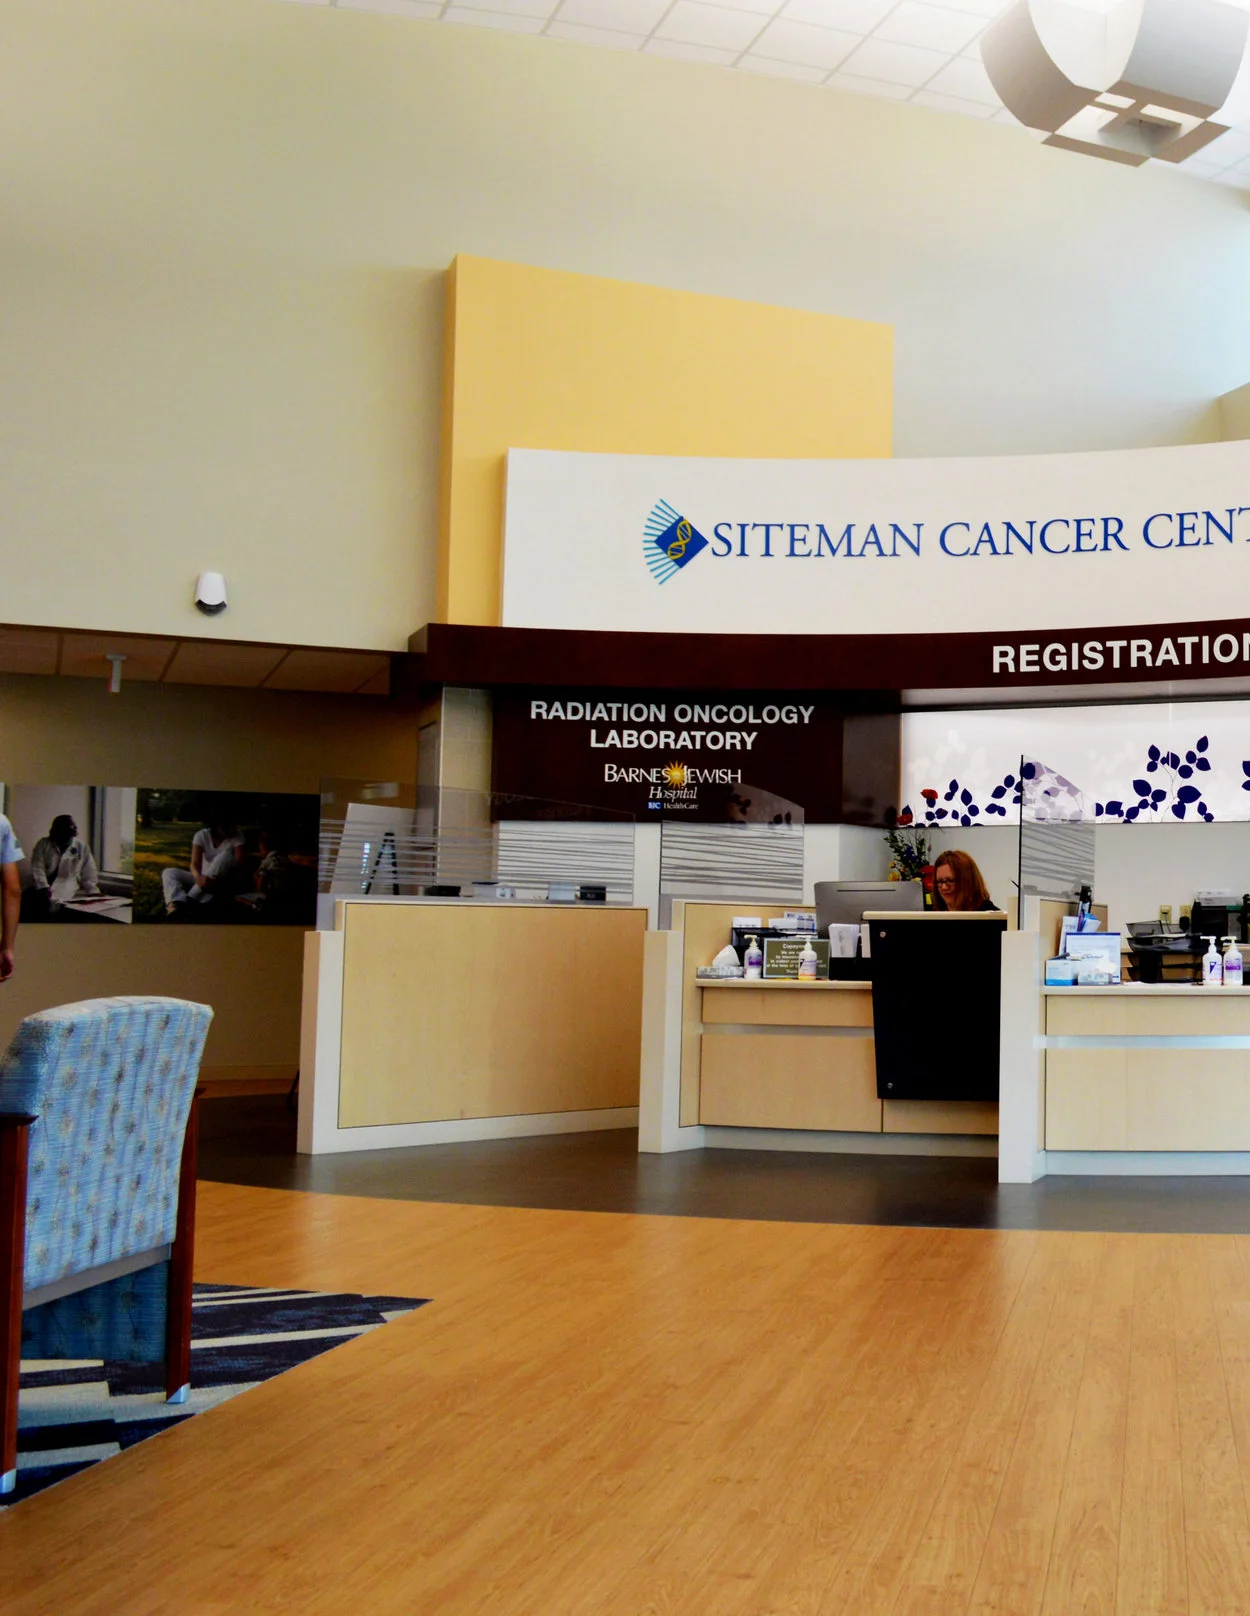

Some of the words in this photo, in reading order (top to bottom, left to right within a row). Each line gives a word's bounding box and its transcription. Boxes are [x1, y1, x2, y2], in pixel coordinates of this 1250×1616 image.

[711, 522, 925, 558] SITEMAN
[939, 516, 1130, 557] CANCER
[530, 701, 666, 723] RADIATION
[674, 704, 815, 724] ONCOLOGY
[590, 729, 758, 750] LABORATORY
[604, 763, 671, 783] BARNES
[682, 765, 741, 786] JEWISH
[648, 786, 698, 802] Hospital
